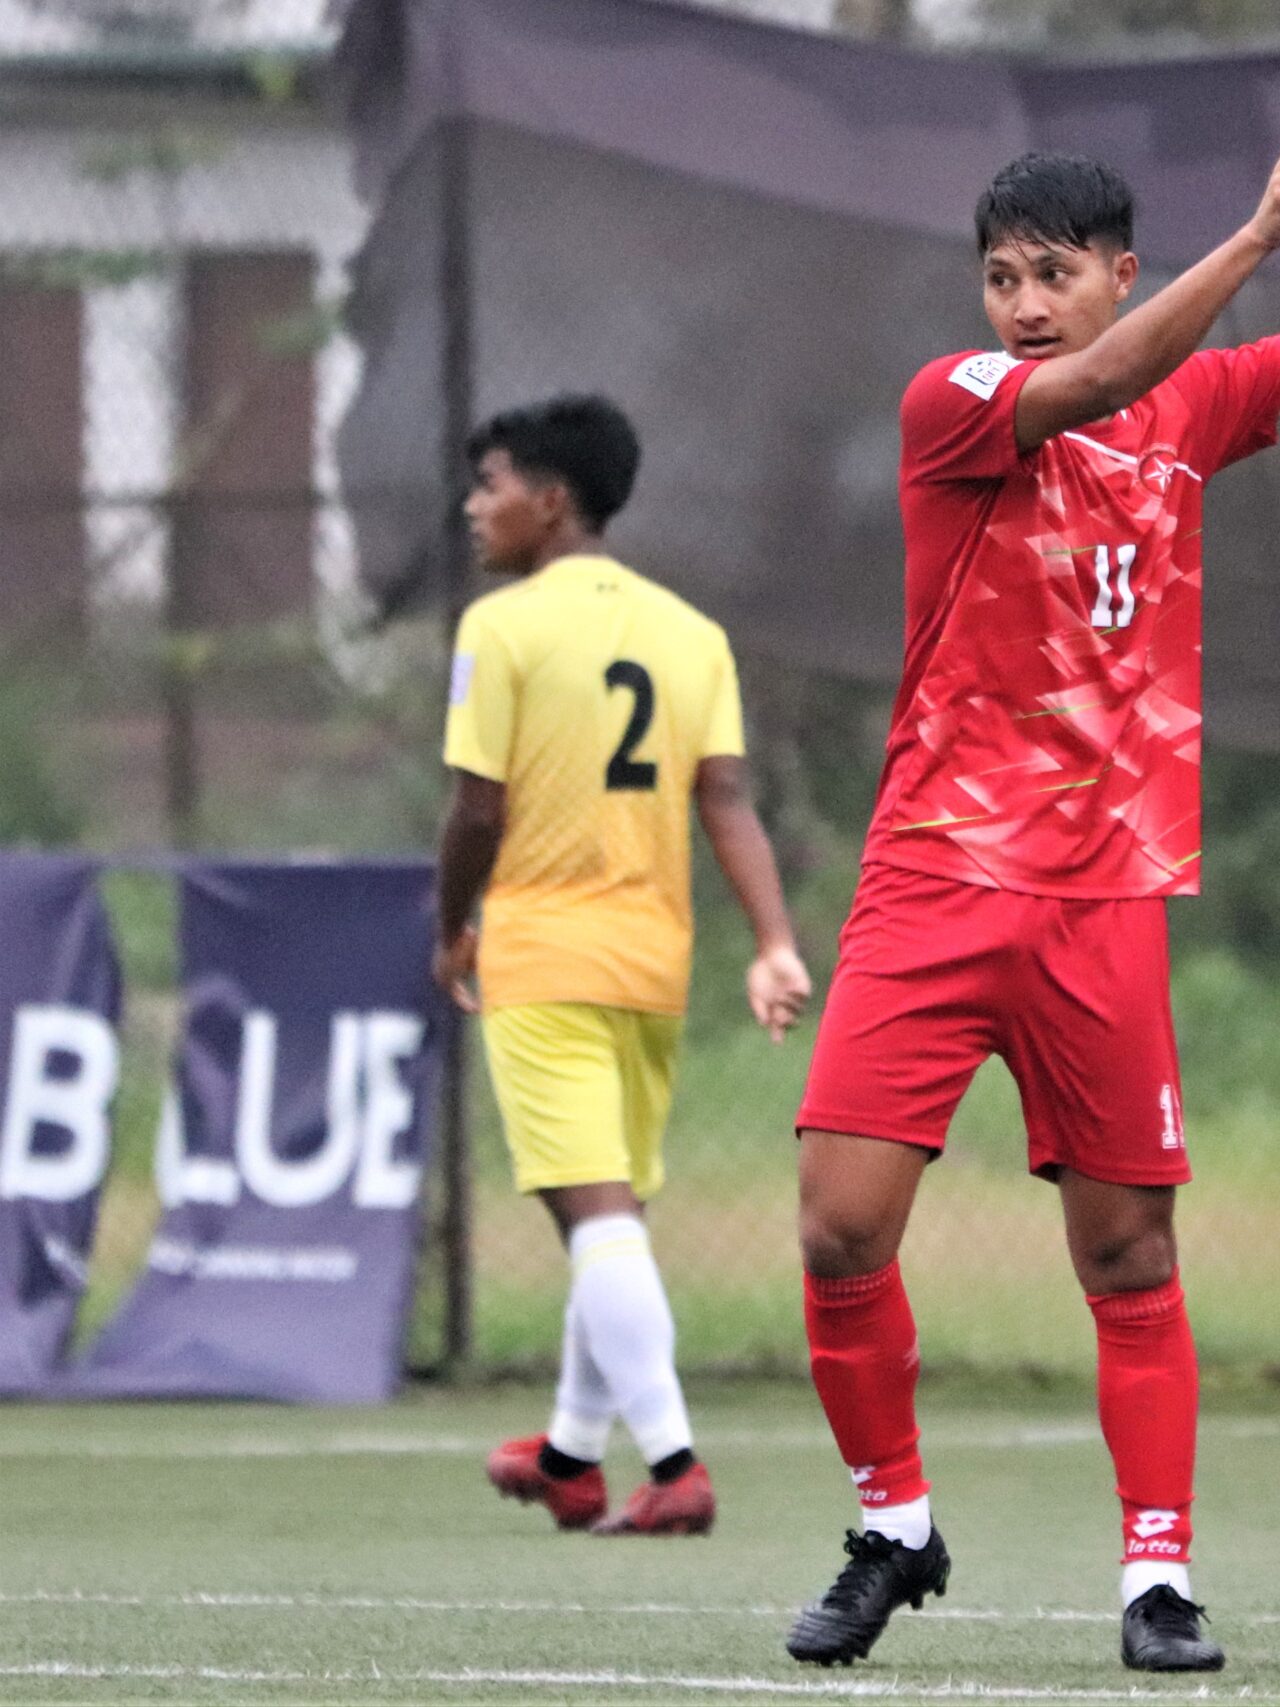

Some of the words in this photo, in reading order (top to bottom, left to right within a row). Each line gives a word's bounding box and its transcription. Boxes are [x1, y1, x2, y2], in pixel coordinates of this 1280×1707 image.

[1090, 543, 1137, 628] 11
[604, 659, 657, 790] 2
[1128, 1539, 1181, 1554] lotto
